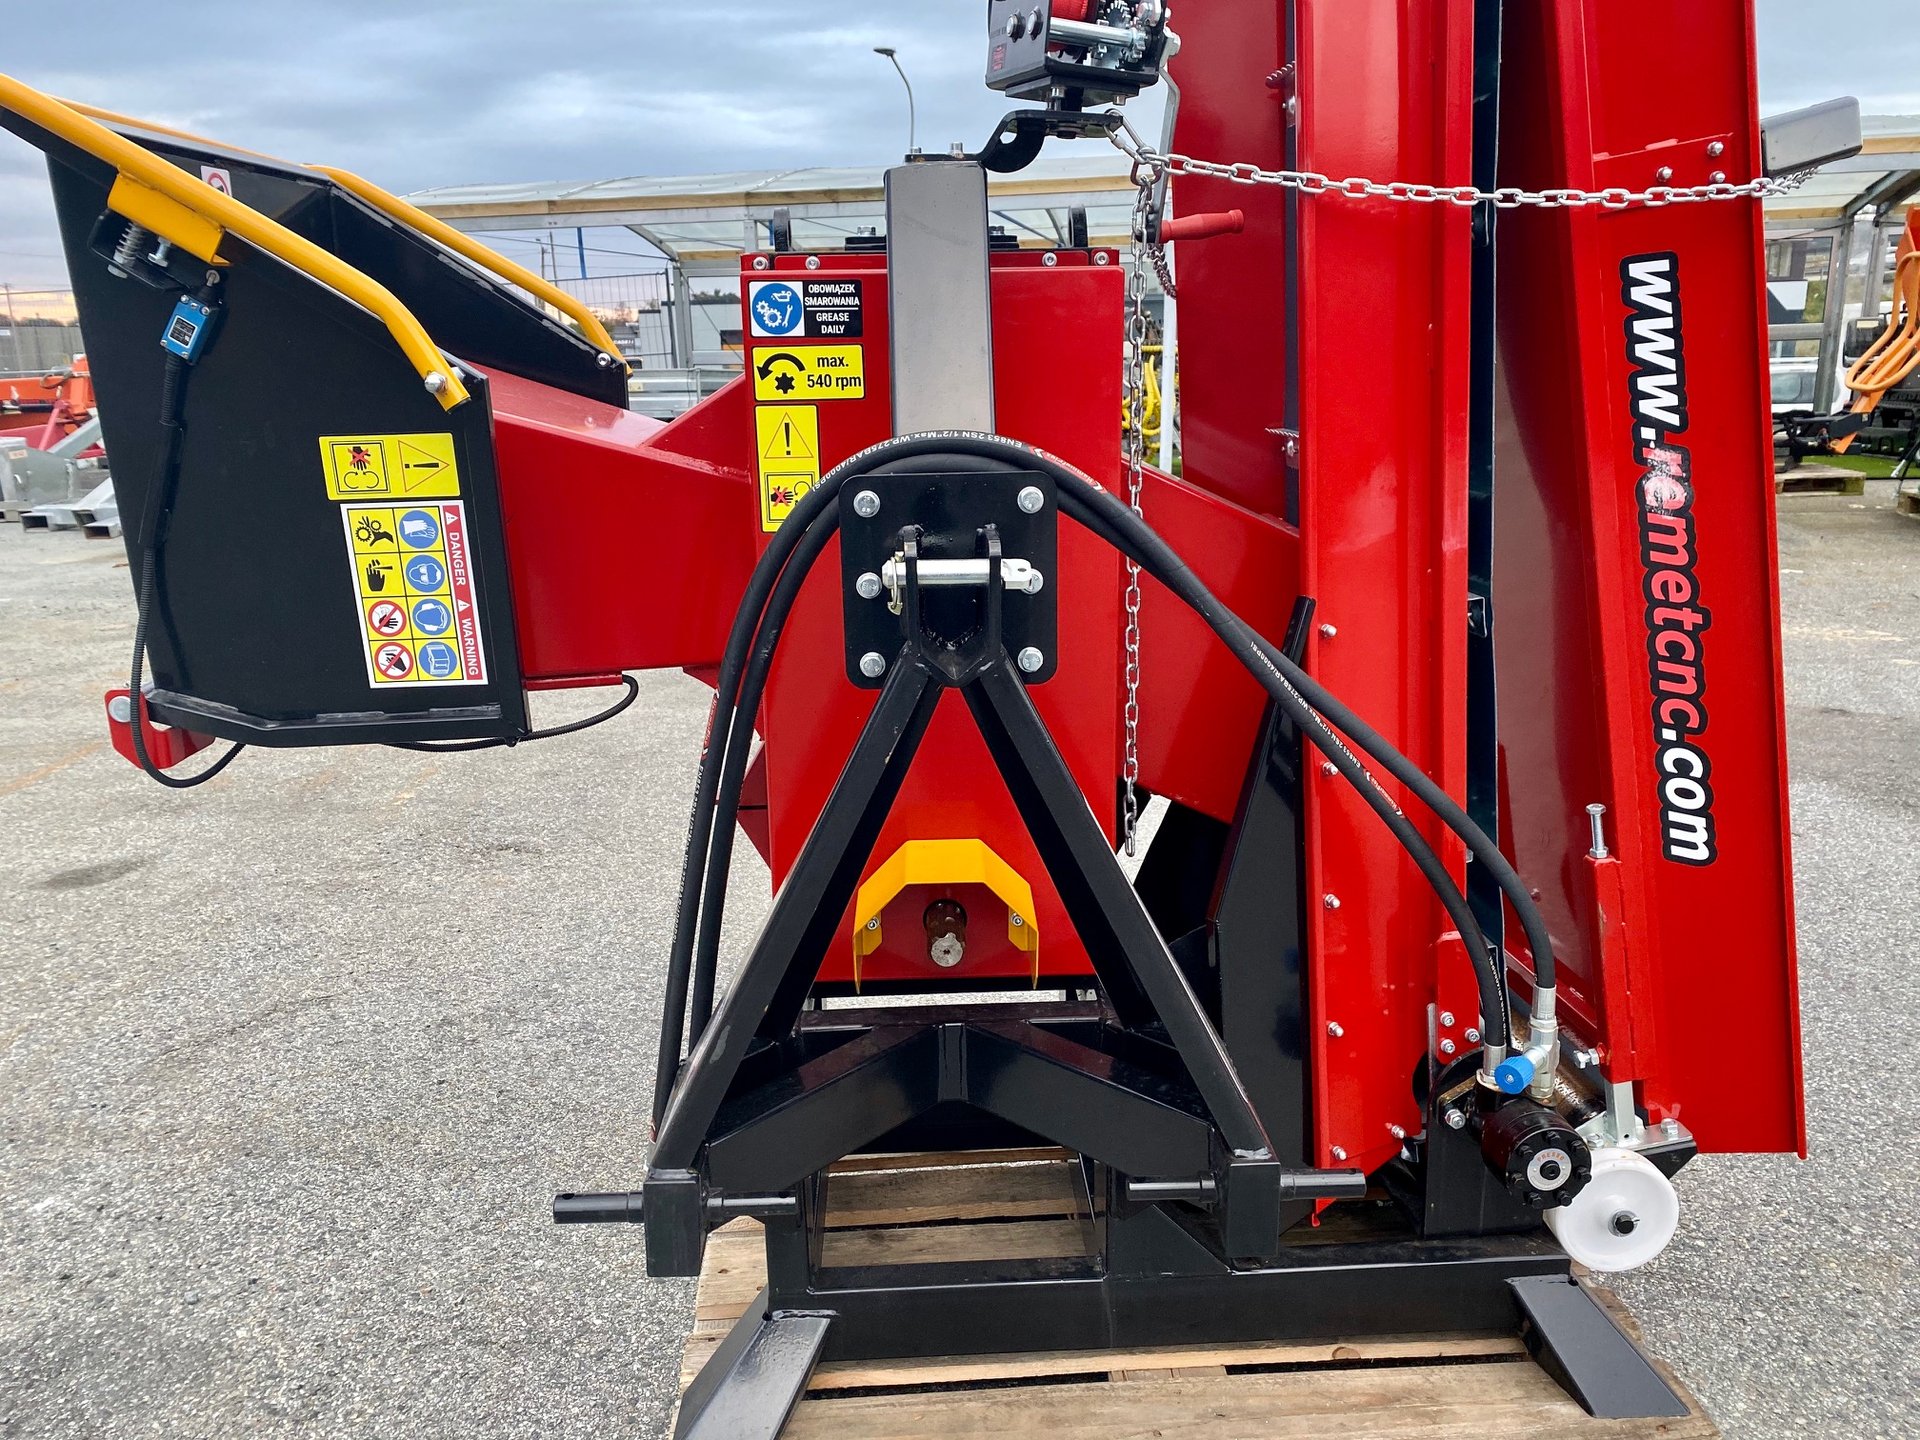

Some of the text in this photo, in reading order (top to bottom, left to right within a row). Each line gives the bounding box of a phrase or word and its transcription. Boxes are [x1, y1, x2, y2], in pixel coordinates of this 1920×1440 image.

[808, 285, 855, 295] OBOWIĄZEK
[804, 296, 860, 307] SMAROWANIA
[816, 312, 850, 322] GREASE
[821, 324, 845, 334] DAILY
[817, 357, 849, 368] max.
[807, 374, 862, 390] 540 rpm
[962, 431, 986, 440] 2SN
[988, 433, 1022, 448] EN853
[449, 532, 466, 586] DANGER
[1628, 259, 1707, 861] www.remetcnc.com
[461, 618, 478, 676] WARNING
